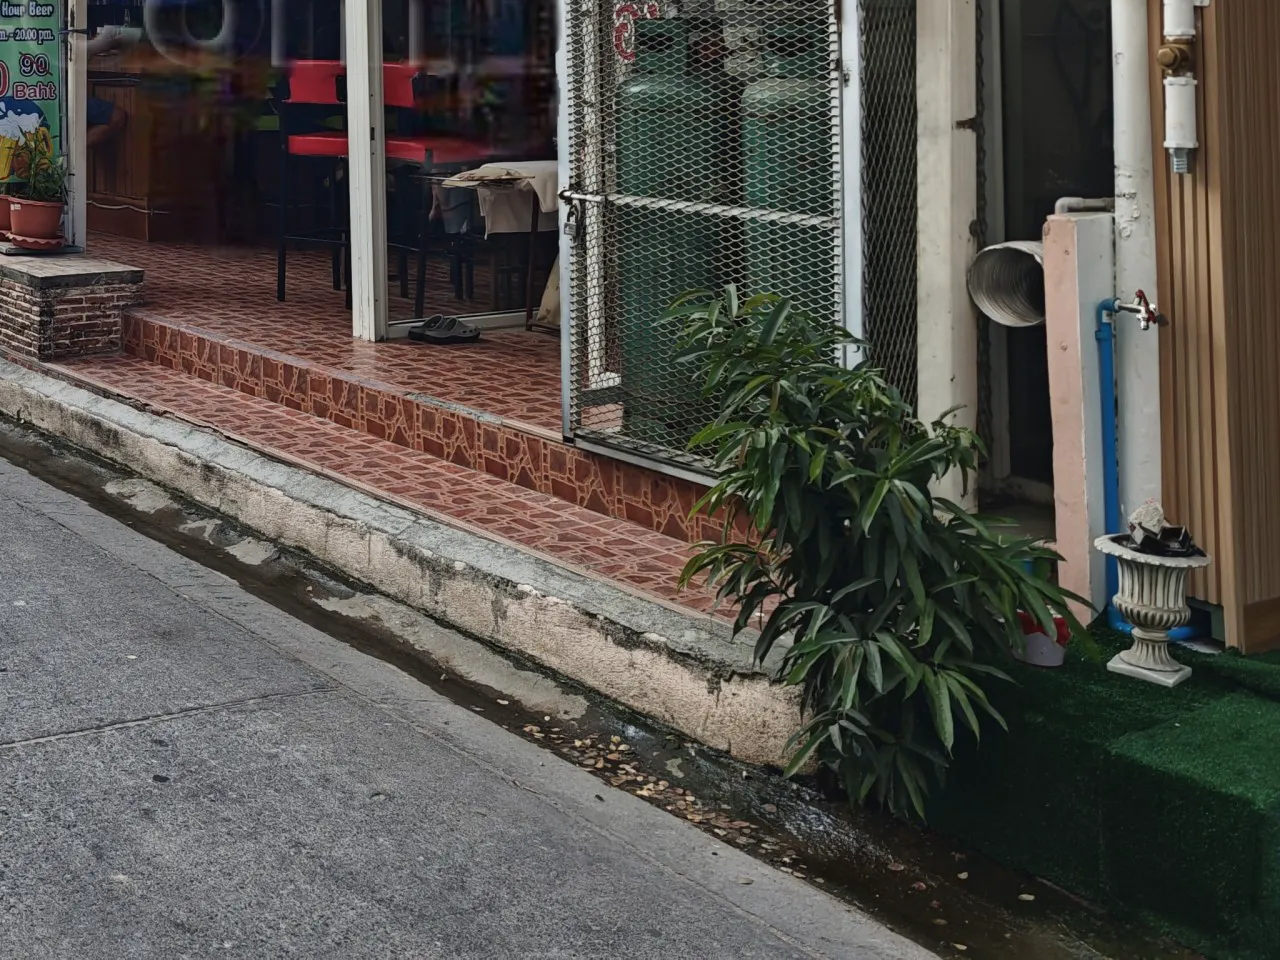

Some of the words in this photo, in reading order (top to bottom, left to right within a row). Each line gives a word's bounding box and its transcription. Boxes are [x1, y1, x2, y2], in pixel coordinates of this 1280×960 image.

[1, 1, 25, 17] Hour
[28, 1, 54, 17] Beer
[15, 28, 37, 41] 20.00
[12, 81, 57, 101] Baht
